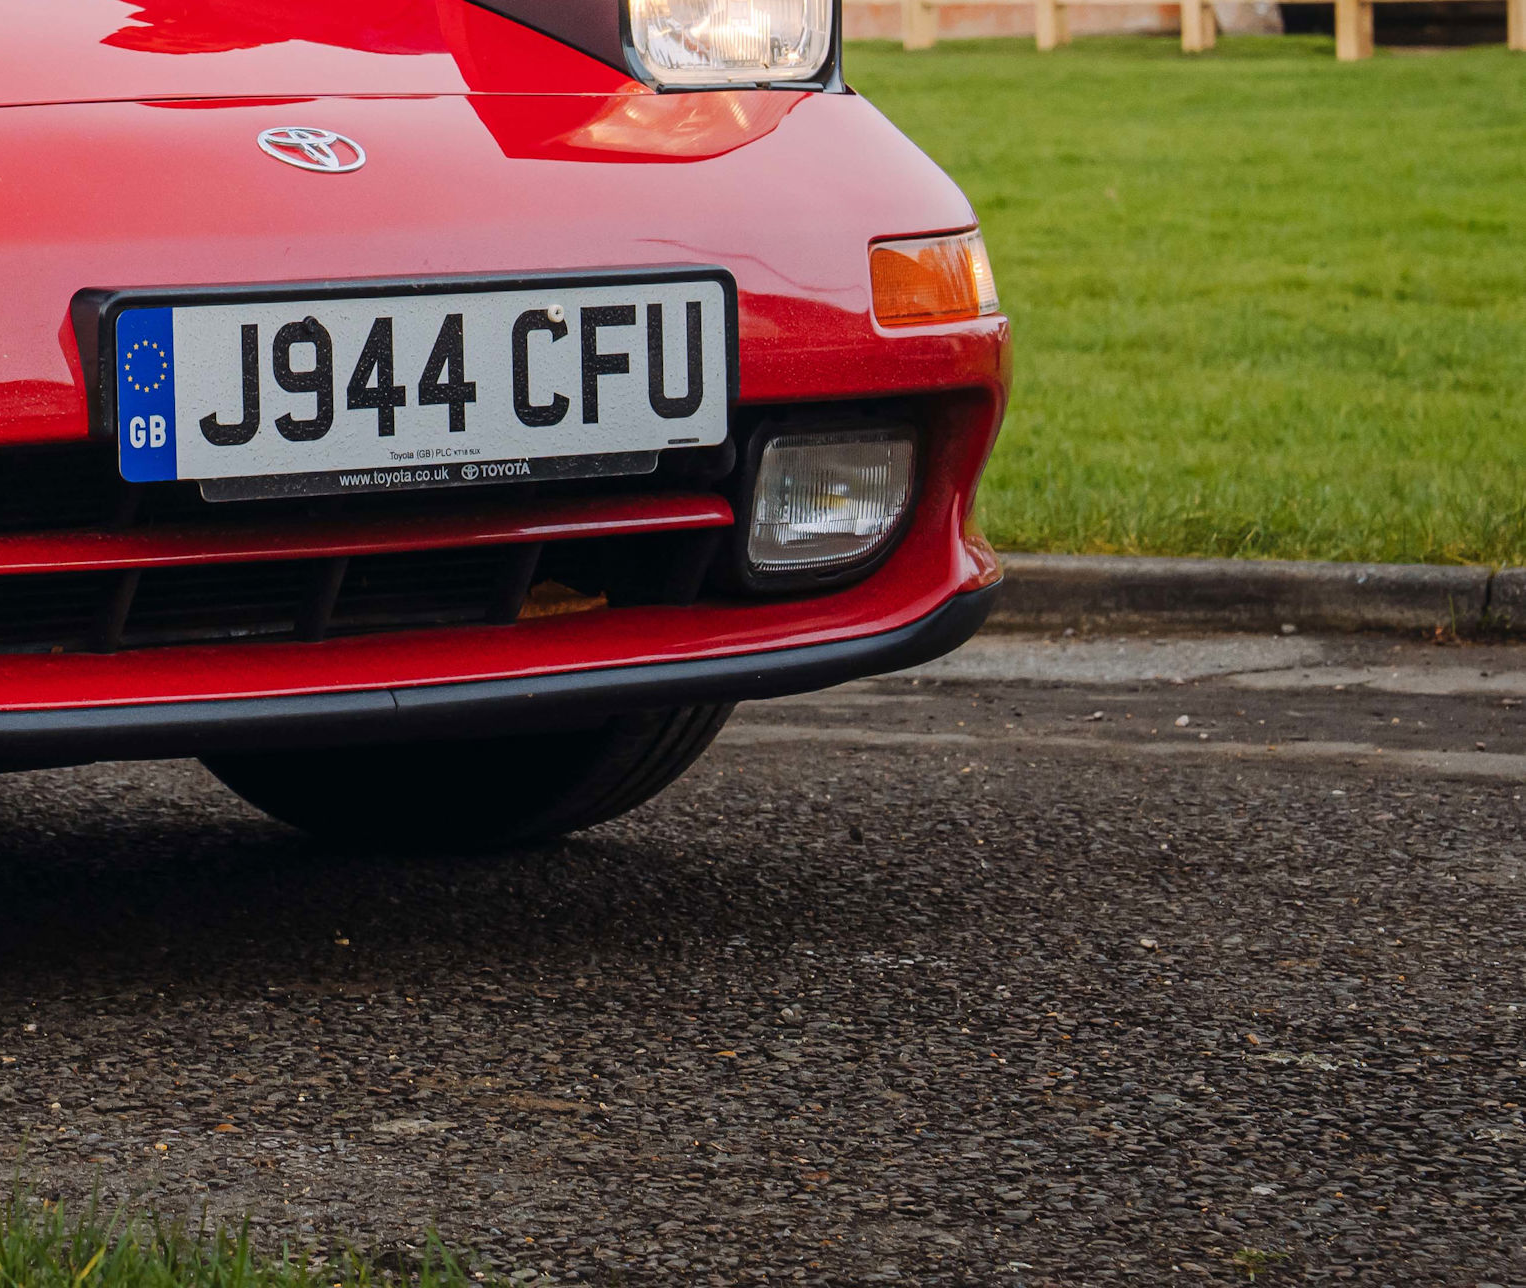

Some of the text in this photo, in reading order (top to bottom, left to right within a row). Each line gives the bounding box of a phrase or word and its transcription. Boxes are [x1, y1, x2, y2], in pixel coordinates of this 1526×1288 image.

[199, 301, 704, 446] J944 CFU
[129, 415, 167, 449] GB
[389, 450, 414, 461] Toyota
[416, 449, 434, 459] (GB)
[436, 448, 451, 457] PLC
[340, 466, 449, 487] www.toyota.co.uk
[480, 463, 530, 478] TOYOTA
